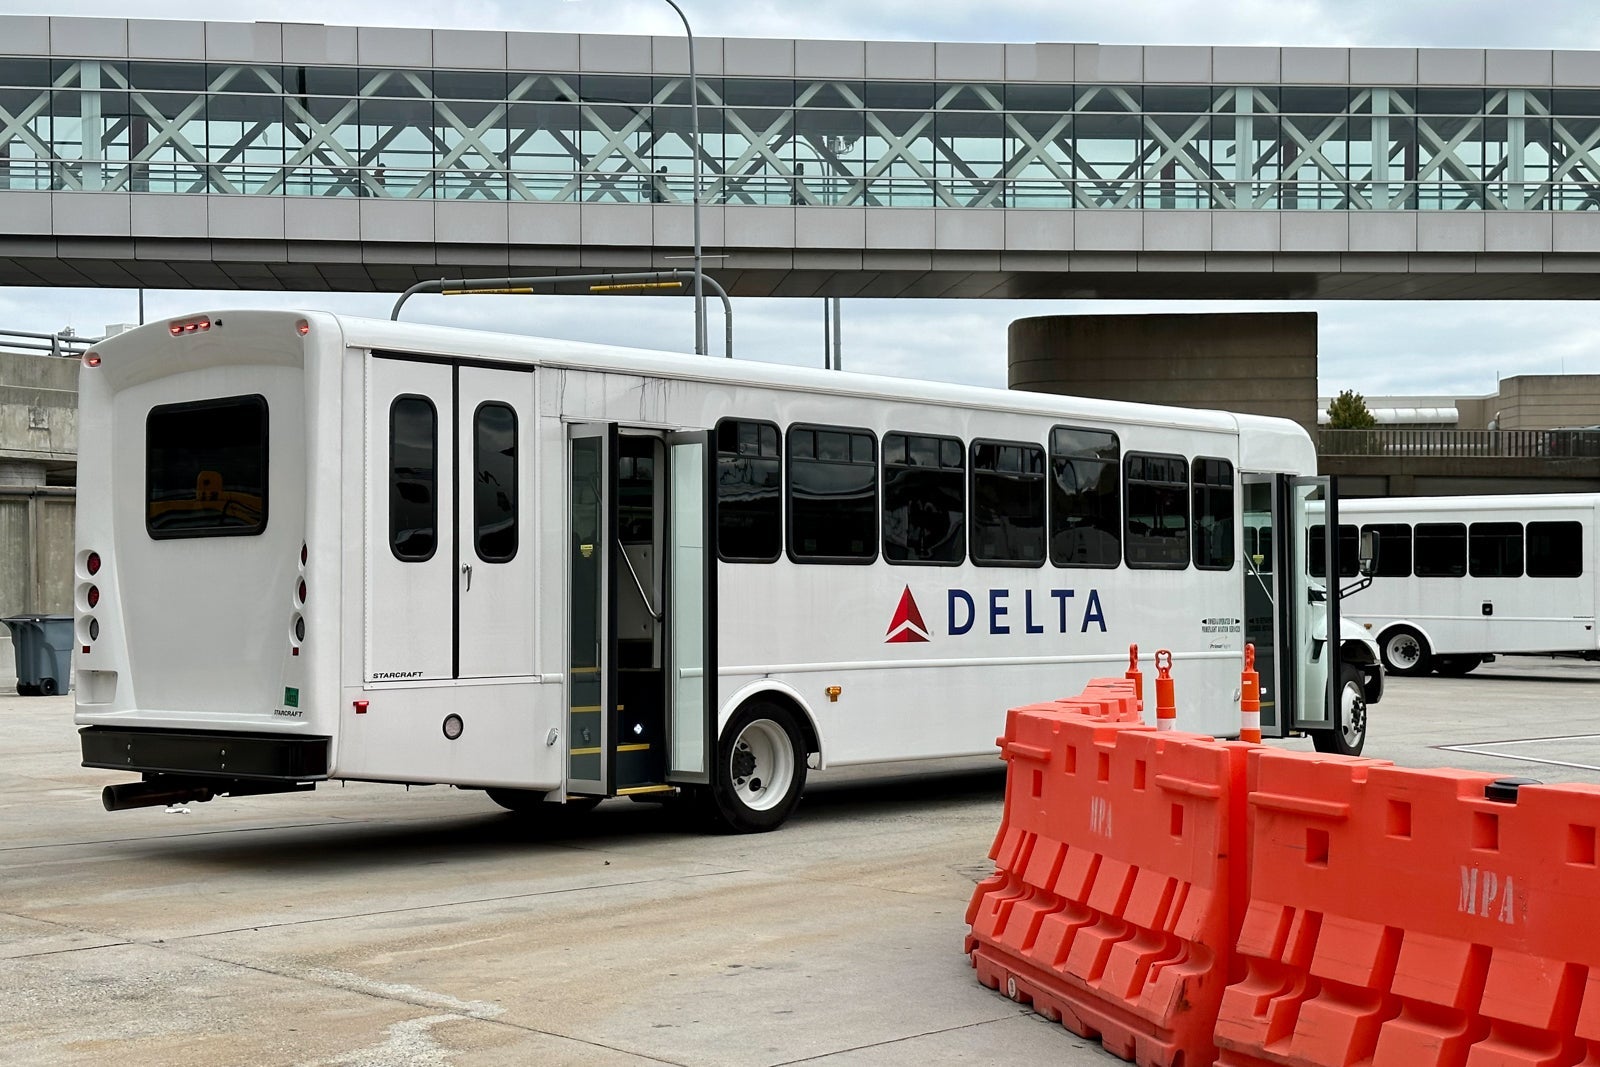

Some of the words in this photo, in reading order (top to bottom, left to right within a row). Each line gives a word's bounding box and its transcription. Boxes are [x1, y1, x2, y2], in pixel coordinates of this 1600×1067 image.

[948, 589, 1108, 636] DELTA
[372, 671, 424, 679] STARCRAFT
[273, 709, 303, 718] STARCRAFT
[1089, 795, 1112, 839] MPA
[1457, 865, 1514, 925] MPA
